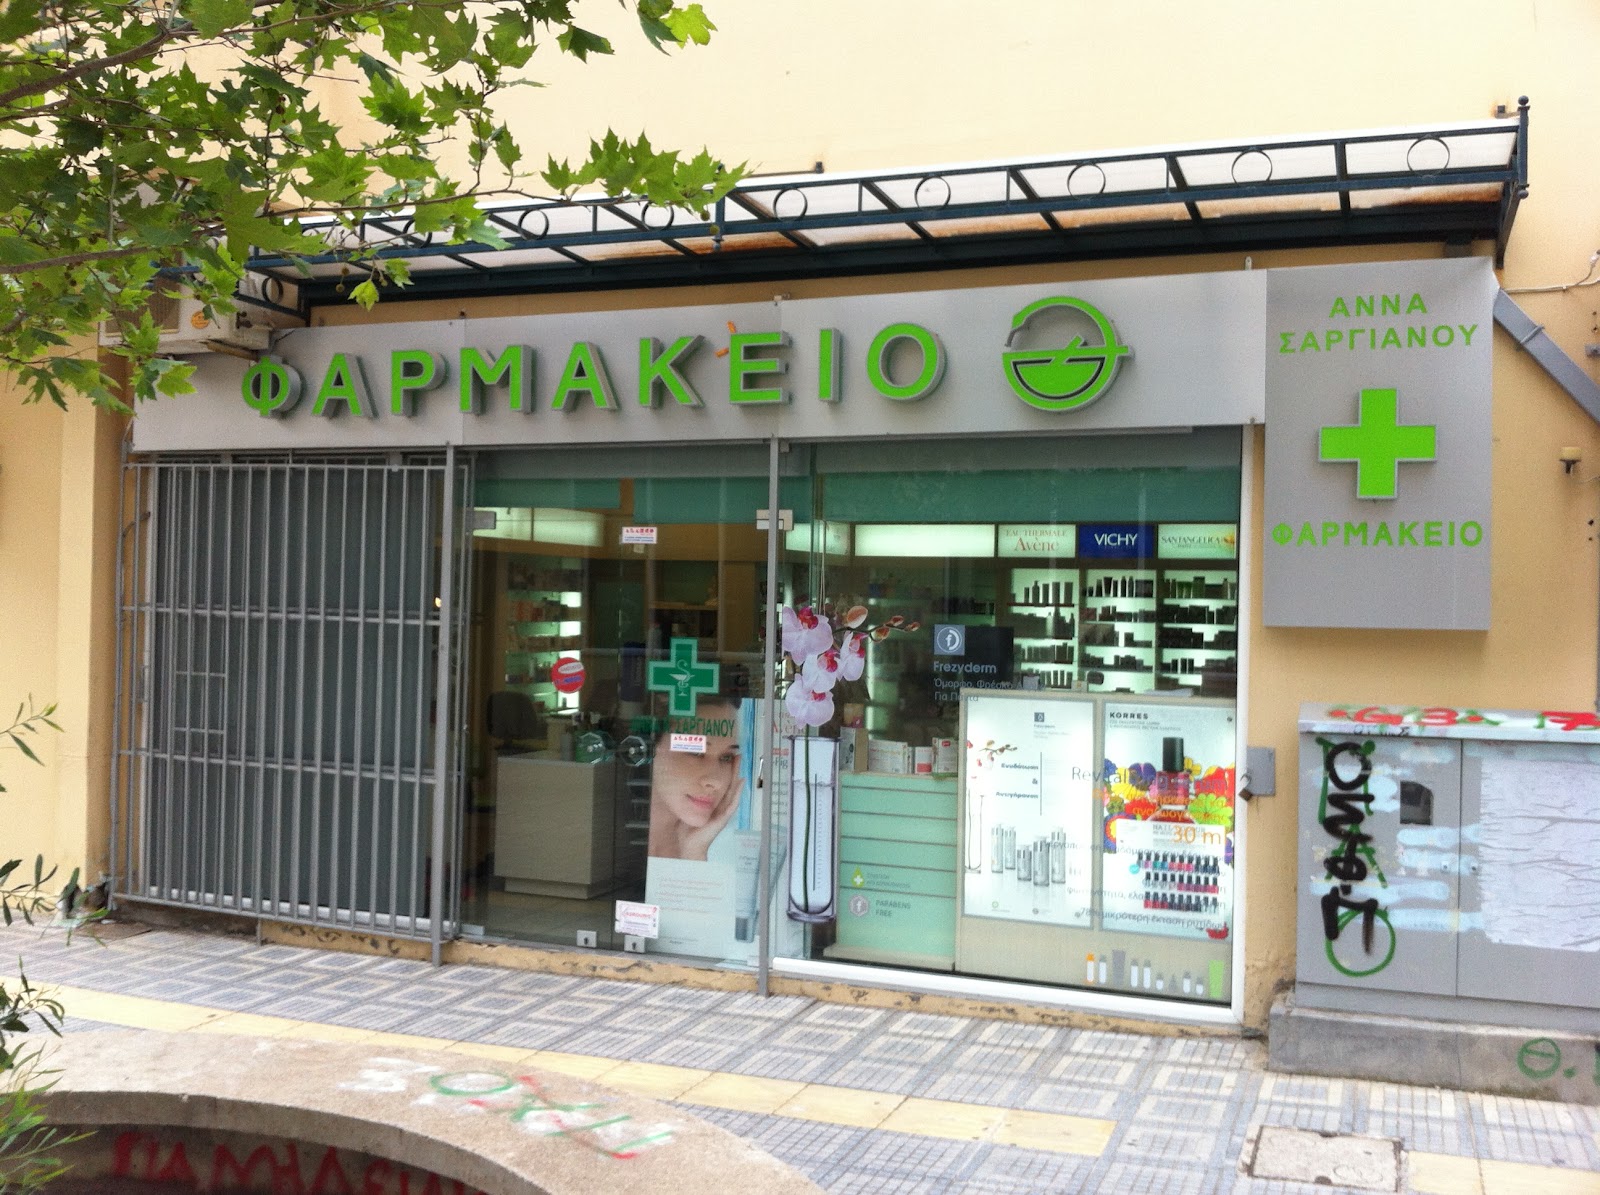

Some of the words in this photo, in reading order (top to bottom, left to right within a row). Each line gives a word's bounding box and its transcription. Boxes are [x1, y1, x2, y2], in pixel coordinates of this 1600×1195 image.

[1329, 293, 1427, 318] ΑΝΝΑ
[1279, 324, 1478, 354] ΣΑΡΓΙΑΝΟΥ
[241, 321, 944, 418] ΦΑΡΜΑΚΕΙΟ
[1094, 533, 1138, 546] VICHY
[1271, 520, 1483, 547] ΦΑΡΜΑΚΕΙΟ
[933, 661, 997, 675] Frezyderm
[1109, 711, 1149, 720] KORRES
[1172, 825, 1196, 844] 30
